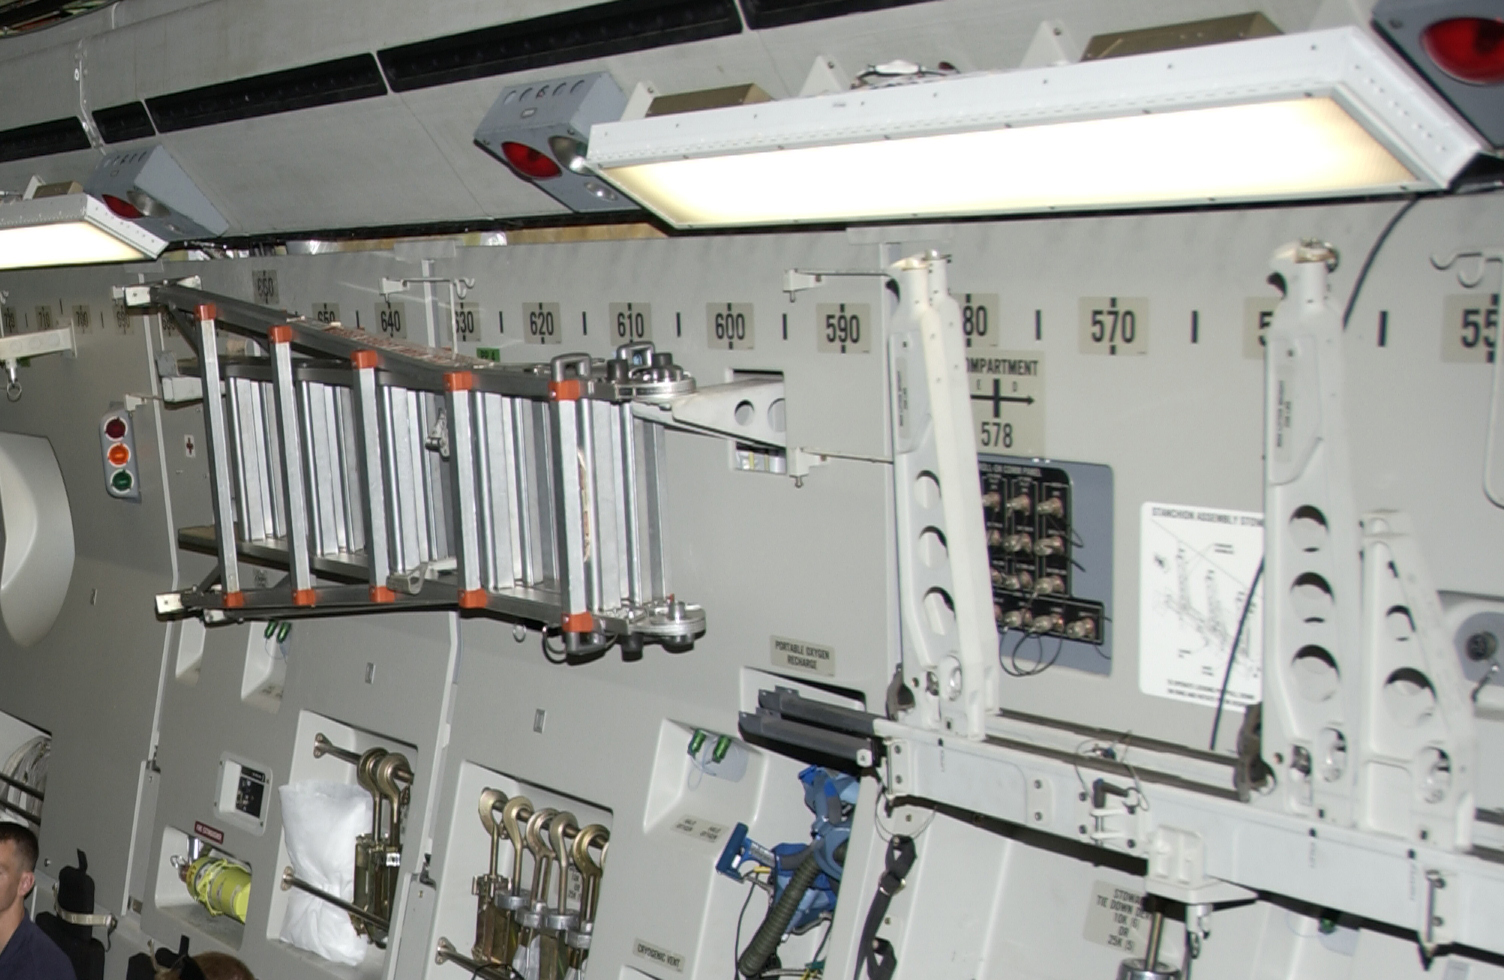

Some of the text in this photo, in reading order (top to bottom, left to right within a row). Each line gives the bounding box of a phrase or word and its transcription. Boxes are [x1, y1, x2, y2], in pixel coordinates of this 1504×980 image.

[380, 313, 401, 332] 640
[529, 311, 555, 336] 620
[617, 312, 645, 338] 610
[715, 313, 746, 340] 600
[826, 314, 860, 344] 590
[963, 305, 988, 337] 80
[1091, 310, 1136, 344] 570
[1461, 309, 1498, 348] 55
[966, 357, 1039, 377] OMPARTMENT
[981, 421, 1014, 449] 578
[775, 639, 830, 661] PORTABLE OXYGEN
[786, 653, 817, 670] RECHARGE
[1097, 894, 1109, 908] TIE
[1109, 899, 1134, 915] DOWN
[1117, 925, 1130, 938] OR
[666, 954, 681, 968] VENT
